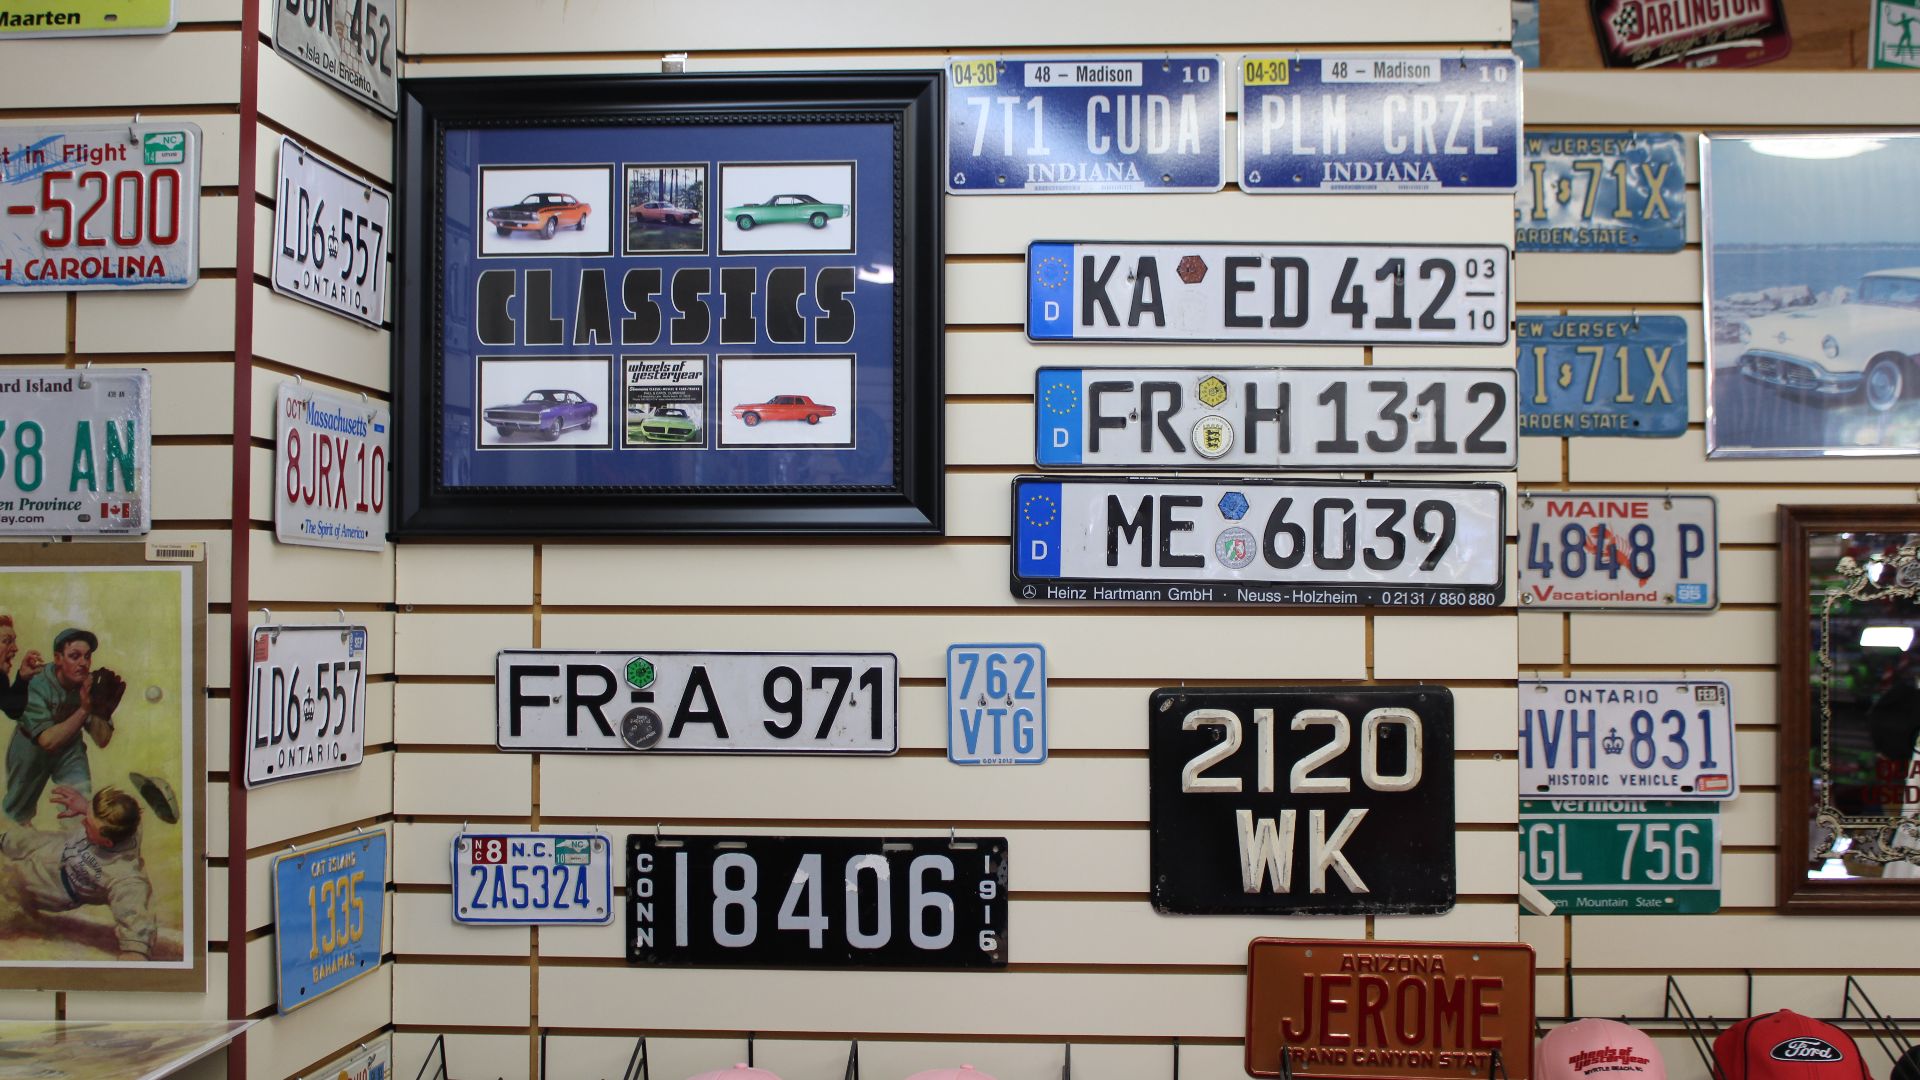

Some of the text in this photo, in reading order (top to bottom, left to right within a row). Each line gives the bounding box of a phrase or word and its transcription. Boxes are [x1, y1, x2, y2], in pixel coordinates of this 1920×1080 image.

[349, 0, 392, 77] 452
[305, 42, 371, 93] Isla Del Encanto
[955, 63, 995, 85] 04-30
[1034, 66, 1051, 83] 48
[1076, 65, 1133, 83] Madison
[1182, 66, 1211, 83] 10
[1246, 62, 1287, 82] 04-30
[1331, 62, 1348, 78] 48
[1374, 61, 1431, 79] Madison
[1479, 66, 1508, 82] 10
[967, 94, 1200, 157] 7T1 CUDA
[1261, 94, 1498, 155] PLM CRZE
[163, 136, 177, 144] NC
[1551, 138, 1629, 155] JERSEY
[26, 146, 45, 163] in
[63, 143, 127, 165] Flight
[1027, 162, 1140, 182] INDIANA
[1323, 161, 1438, 182] INDIANA
[1573, 160, 1670, 220] 71X
[283, 177, 383, 292] LD6 557
[1516, 228, 1628, 244] ARDEN STATE
[25, 255, 165, 281] CAROLINA
[1466, 258, 1496, 279] 03
[303, 271, 361, 308] ONTARIO
[1082, 255, 1456, 329] KA ED 412
[476, 265, 857, 346] CLASSICS
[1044, 301, 1060, 321] D
[1468, 310, 1496, 330] 10
[1517, 322, 1630, 338] EW JERSEY
[628, 360, 687, 373] wheels of
[631, 370, 703, 383] yesteryear
[1576, 346, 1673, 404] 71X
[26, 378, 73, 393] Island
[286, 397, 368, 438] OCT Massachusetts
[1089, 380, 1186, 453] FR
[1245, 381, 1291, 454] H
[1316, 381, 1507, 454] 1312
[1519, 414, 1630, 429] ARDEN STATE
[1053, 428, 1069, 448] D
[69, 420, 135, 493] AN
[286, 427, 385, 514] 8JRX 10
[19, 497, 82, 511] Province
[1546, 501, 1649, 518] MAINE
[305, 519, 365, 540] The Spirit of America
[1107, 494, 1205, 568] ME
[1263, 497, 1456, 571] 6039
[1031, 540, 1048, 560] D
[1524, 523, 1705, 579] 4848 P
[1047, 586, 1087, 600] Heinz
[1093, 586, 1161, 601] Hartmann
[1168, 587, 1213, 601] GmbH
[1532, 585, 1658, 602] Vacationland
[958, 652, 1036, 700] 762
[255, 661, 361, 749] LD6 557
[762, 665, 883, 740] 971
[1564, 689, 1659, 704] ONTARIO
[959, 708, 1034, 755] VTG
[1630, 709, 1718, 770] 831
[278, 741, 340, 769] ONTARIO
[1182, 707, 1423, 793] 2120
[1548, 774, 1679, 786] HISTORIC VEHICLE
[486, 839, 503, 863] 8
[512, 842, 553, 858] N.C.
[571, 840, 584, 848] NC
[1236, 808, 1370, 894] WK
[1521, 823, 1700, 881] GL 756
[311, 859, 326, 877] CAT
[556, 854, 566, 864] 10
[470, 864, 591, 909] 2A5324
[636, 853, 654, 948] CONN
[675, 852, 956, 950] 18406
[978, 854, 998, 951] 1916
[1576, 897, 1629, 907] Mountain
[1635, 897, 1663, 907] State
[308, 870, 366, 961] 1335
[312, 951, 356, 985] BAHAMAS
[1339, 953, 1447, 975] ARIZONA
[1280, 972, 1504, 1050] JEROME
[1352, 1048, 1434, 1069] CANYON
[1568, 1046, 1633, 1064] wheels of
[1784, 1040, 1833, 1059] Ford
